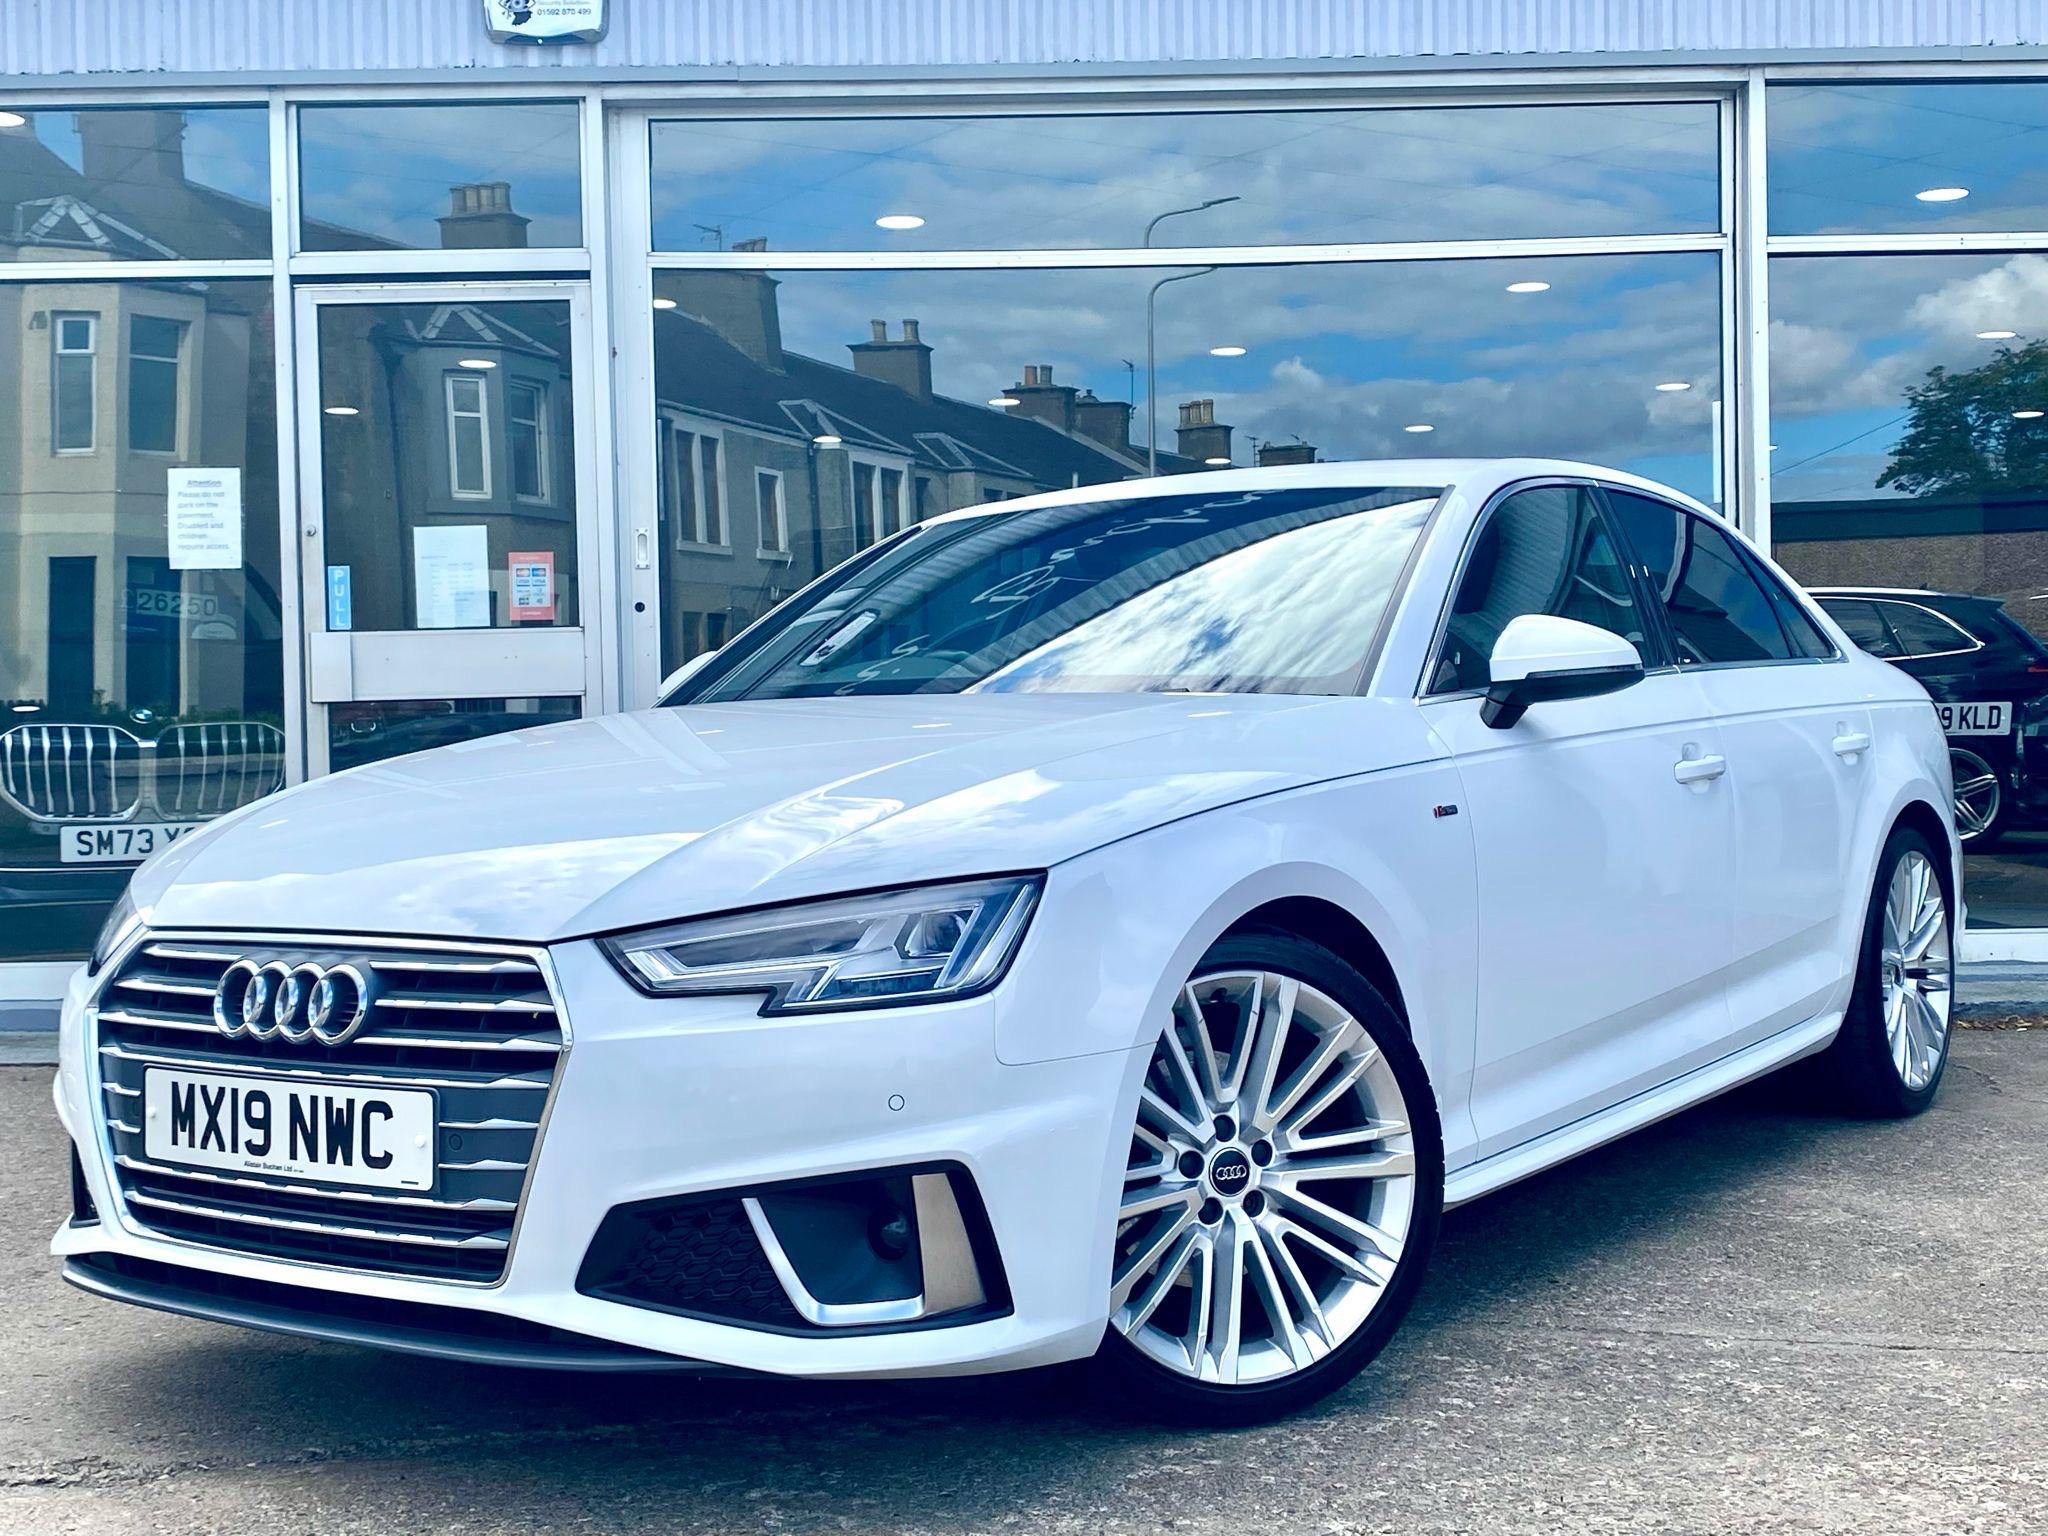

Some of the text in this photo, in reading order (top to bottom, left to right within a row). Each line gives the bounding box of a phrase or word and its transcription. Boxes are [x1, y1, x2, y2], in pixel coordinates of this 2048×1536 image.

[334, 570, 346, 627] PULL
[1937, 705, 2002, 730] 9 KLD
[76, 828, 154, 856] SM73
[171, 1081, 394, 1169] MX19 NWC
